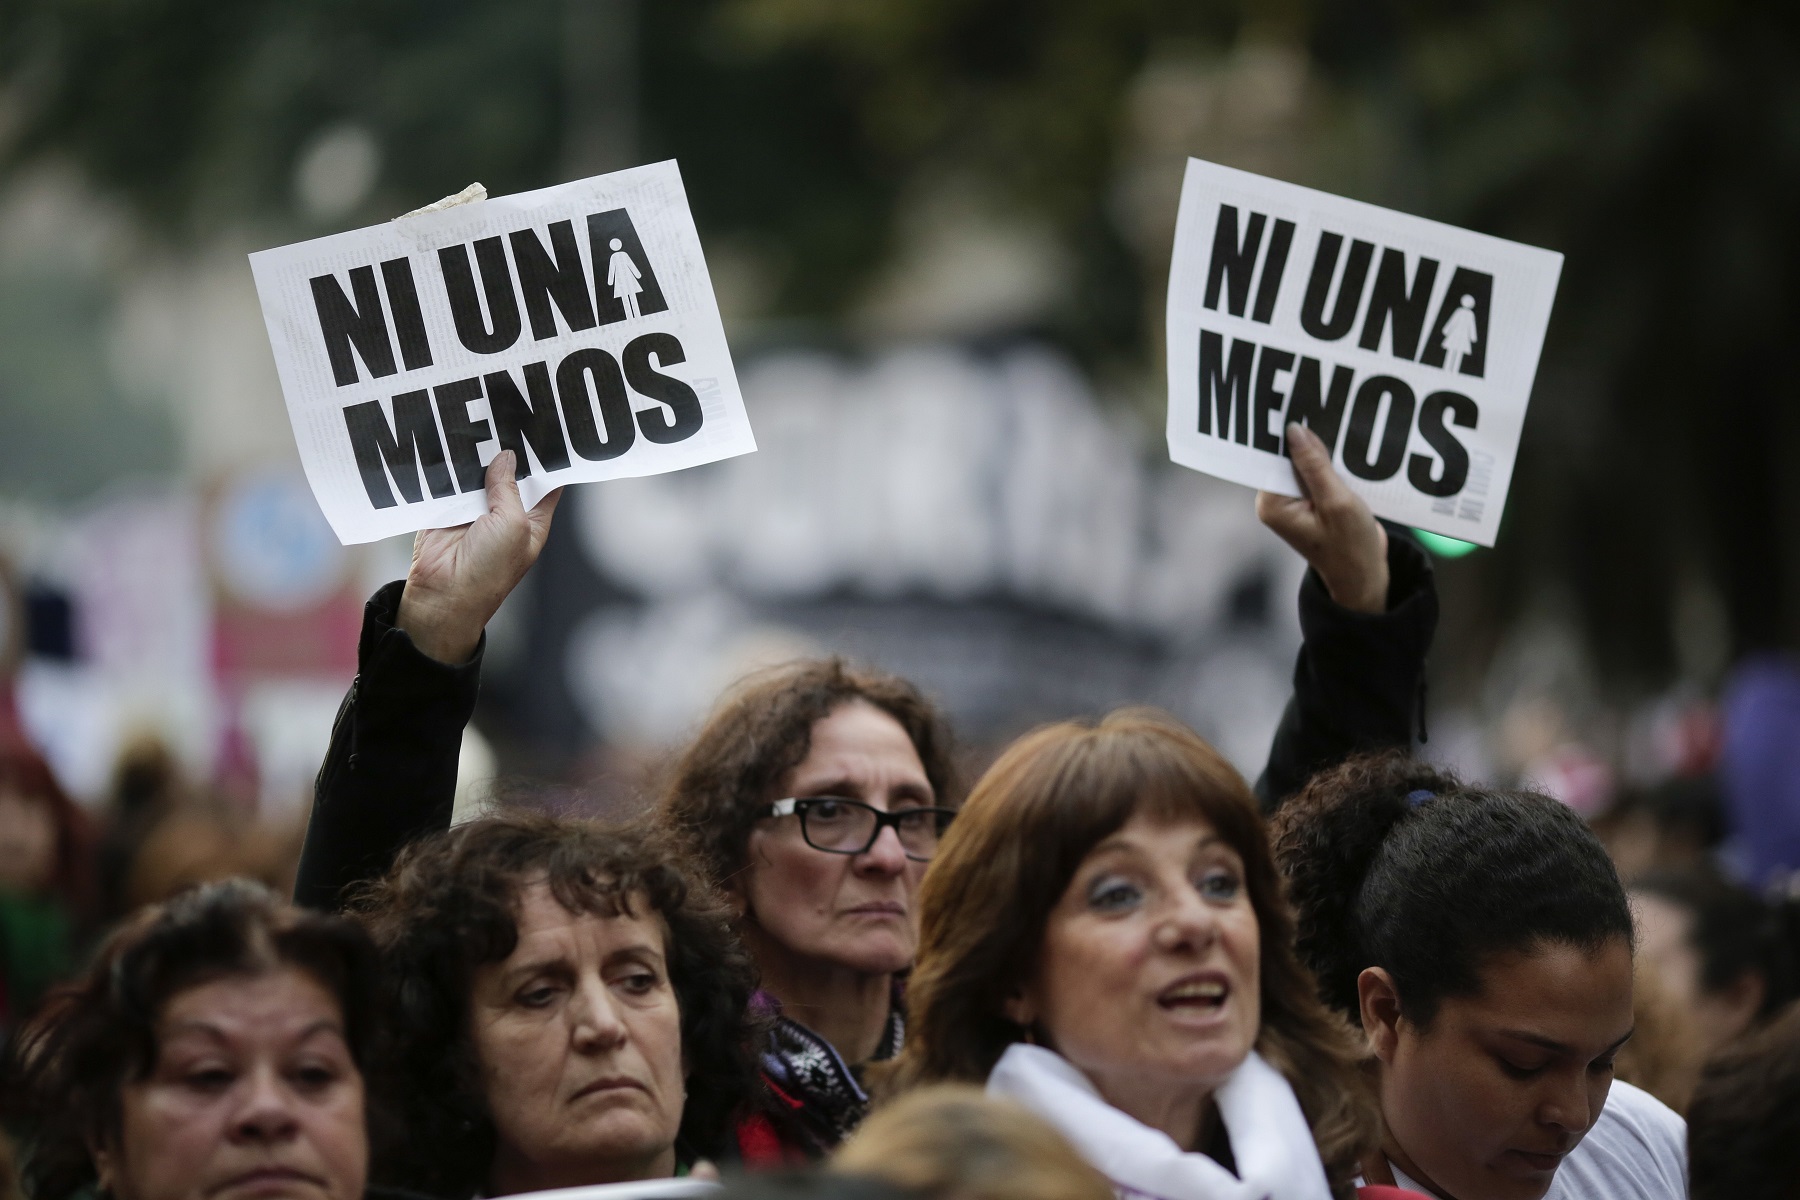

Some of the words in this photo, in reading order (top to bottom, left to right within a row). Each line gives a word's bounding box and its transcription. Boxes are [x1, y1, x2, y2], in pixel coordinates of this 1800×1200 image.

[309, 257, 433, 387] NI
[437, 208, 669, 354] UNA
[1203, 203, 1296, 325] NI
[1300, 230, 1494, 378] UNA
[343, 332, 704, 510] MENOS
[1198, 329, 1479, 497] MENOS
